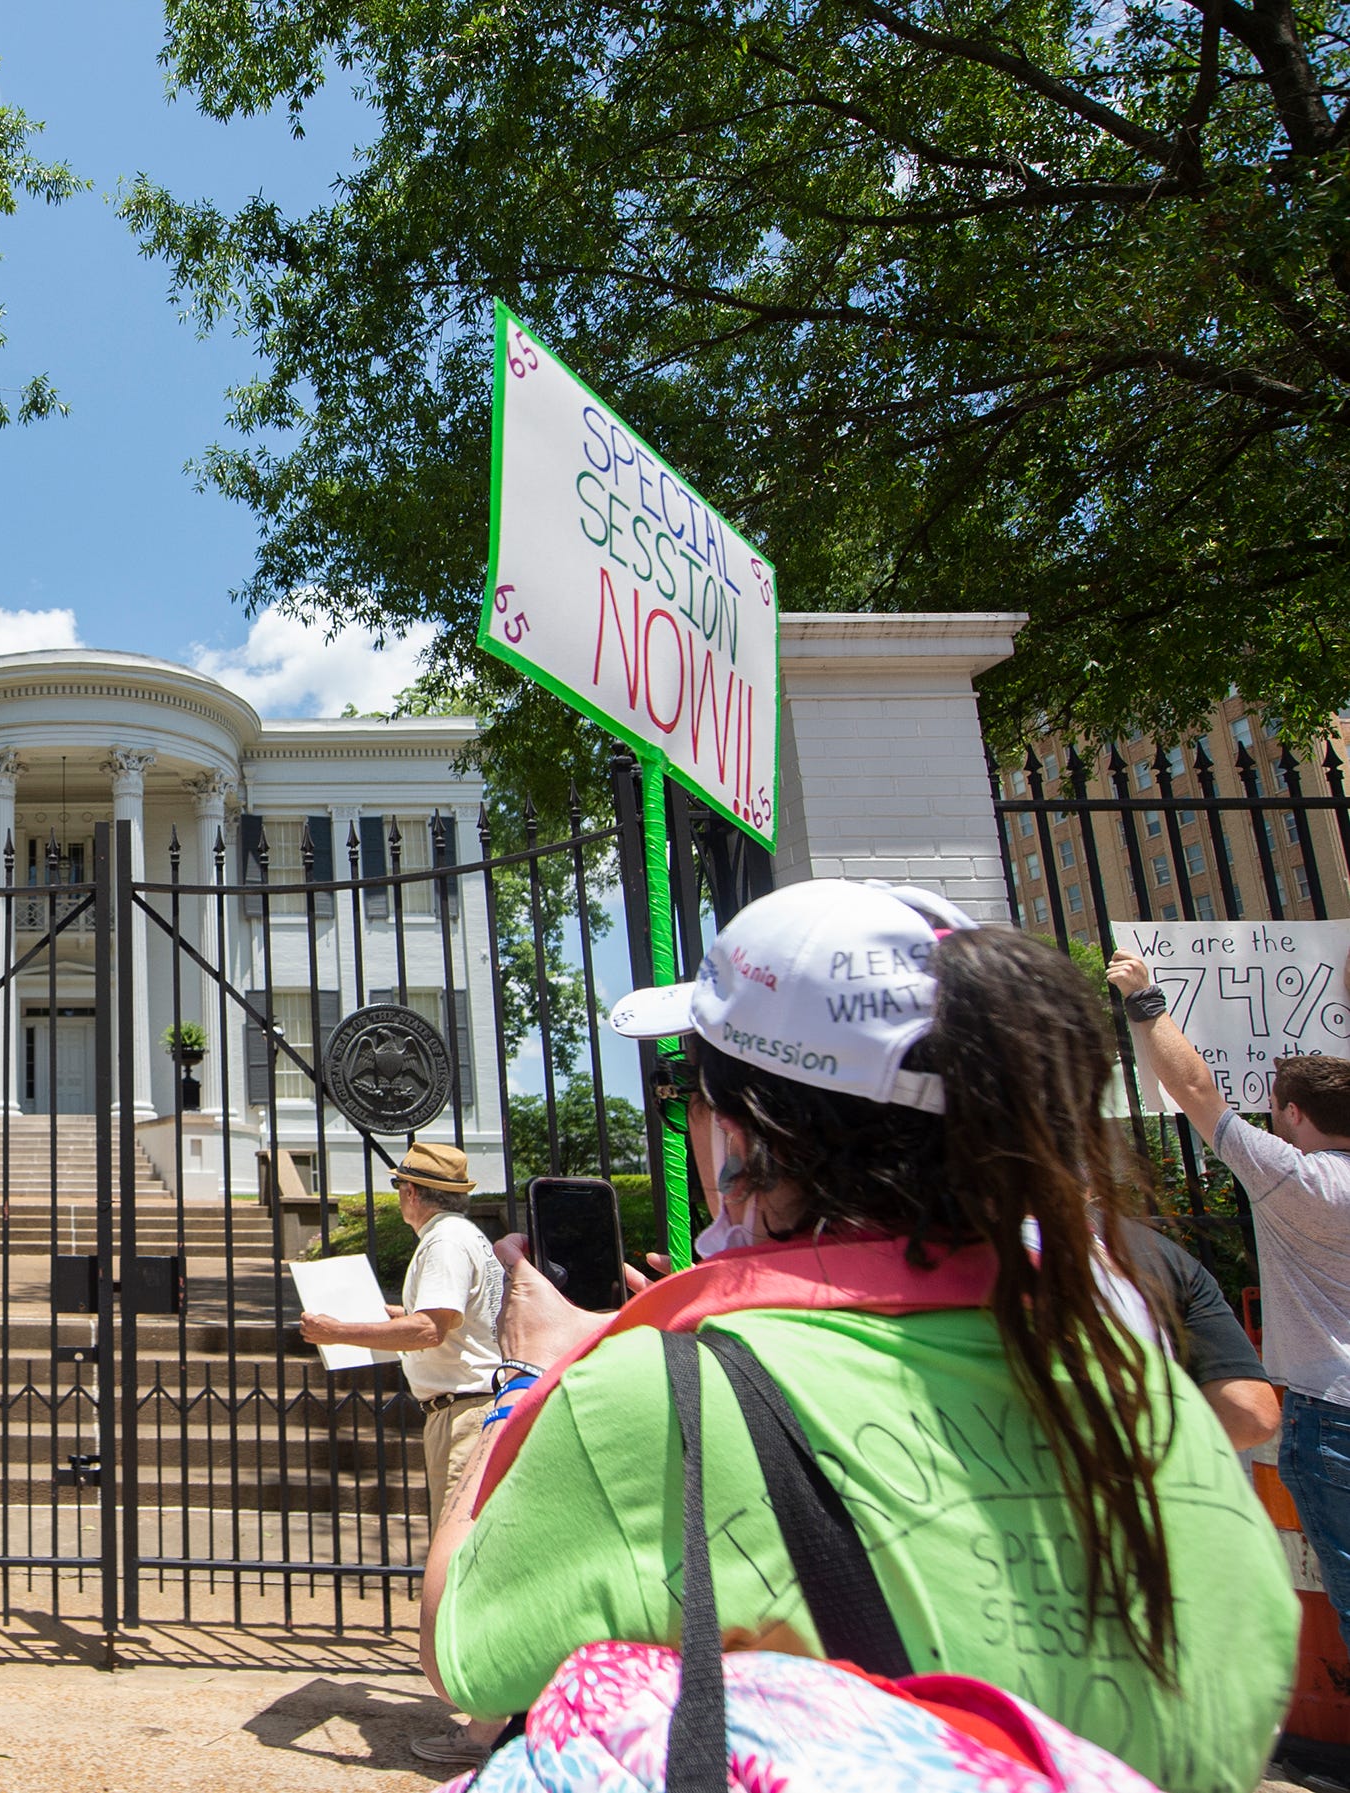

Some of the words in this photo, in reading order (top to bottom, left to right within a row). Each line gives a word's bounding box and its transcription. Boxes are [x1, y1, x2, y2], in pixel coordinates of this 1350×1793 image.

[507, 331, 538, 378] 65
[583, 406, 741, 596] SPECIAL
[576, 470, 738, 665] SESSION
[751, 558, 771, 606] 65
[494, 584, 530, 644] 65
[593, 566, 752, 823] NOW!!
[751, 786, 772, 829] 65
[830, 941, 933, 980] PLEAS
[1133, 930, 1175, 957] We
[1191, 938, 1235, 955] are
[1252, 925, 1296, 953] the
[730, 946, 778, 992] Mania
[722, 1021, 837, 1076] Depression
[1246, 1043, 1266, 1063] to
